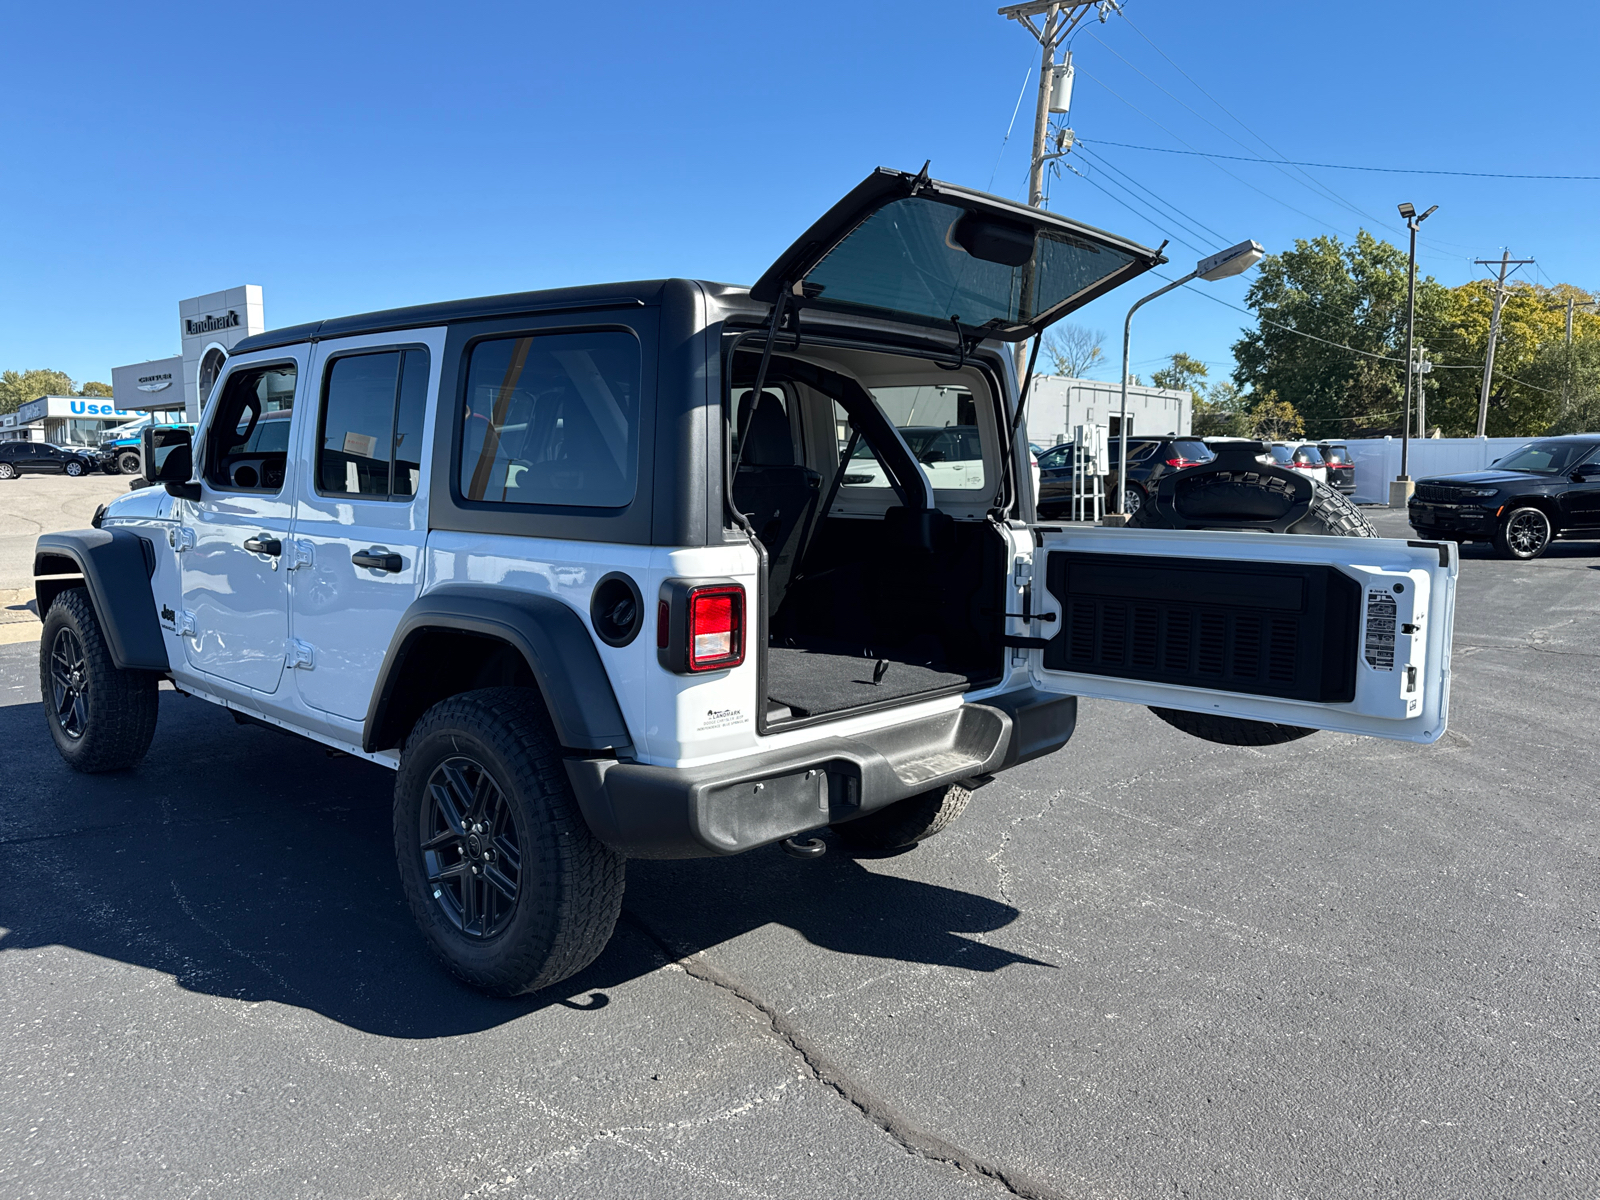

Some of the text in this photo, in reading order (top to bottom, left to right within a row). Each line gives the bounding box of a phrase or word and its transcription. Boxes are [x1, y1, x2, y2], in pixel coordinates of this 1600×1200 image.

[185, 311, 239, 335] Landmark
[161, 604, 176, 625] Jeep
[713, 709, 740, 720] LANDMARK
